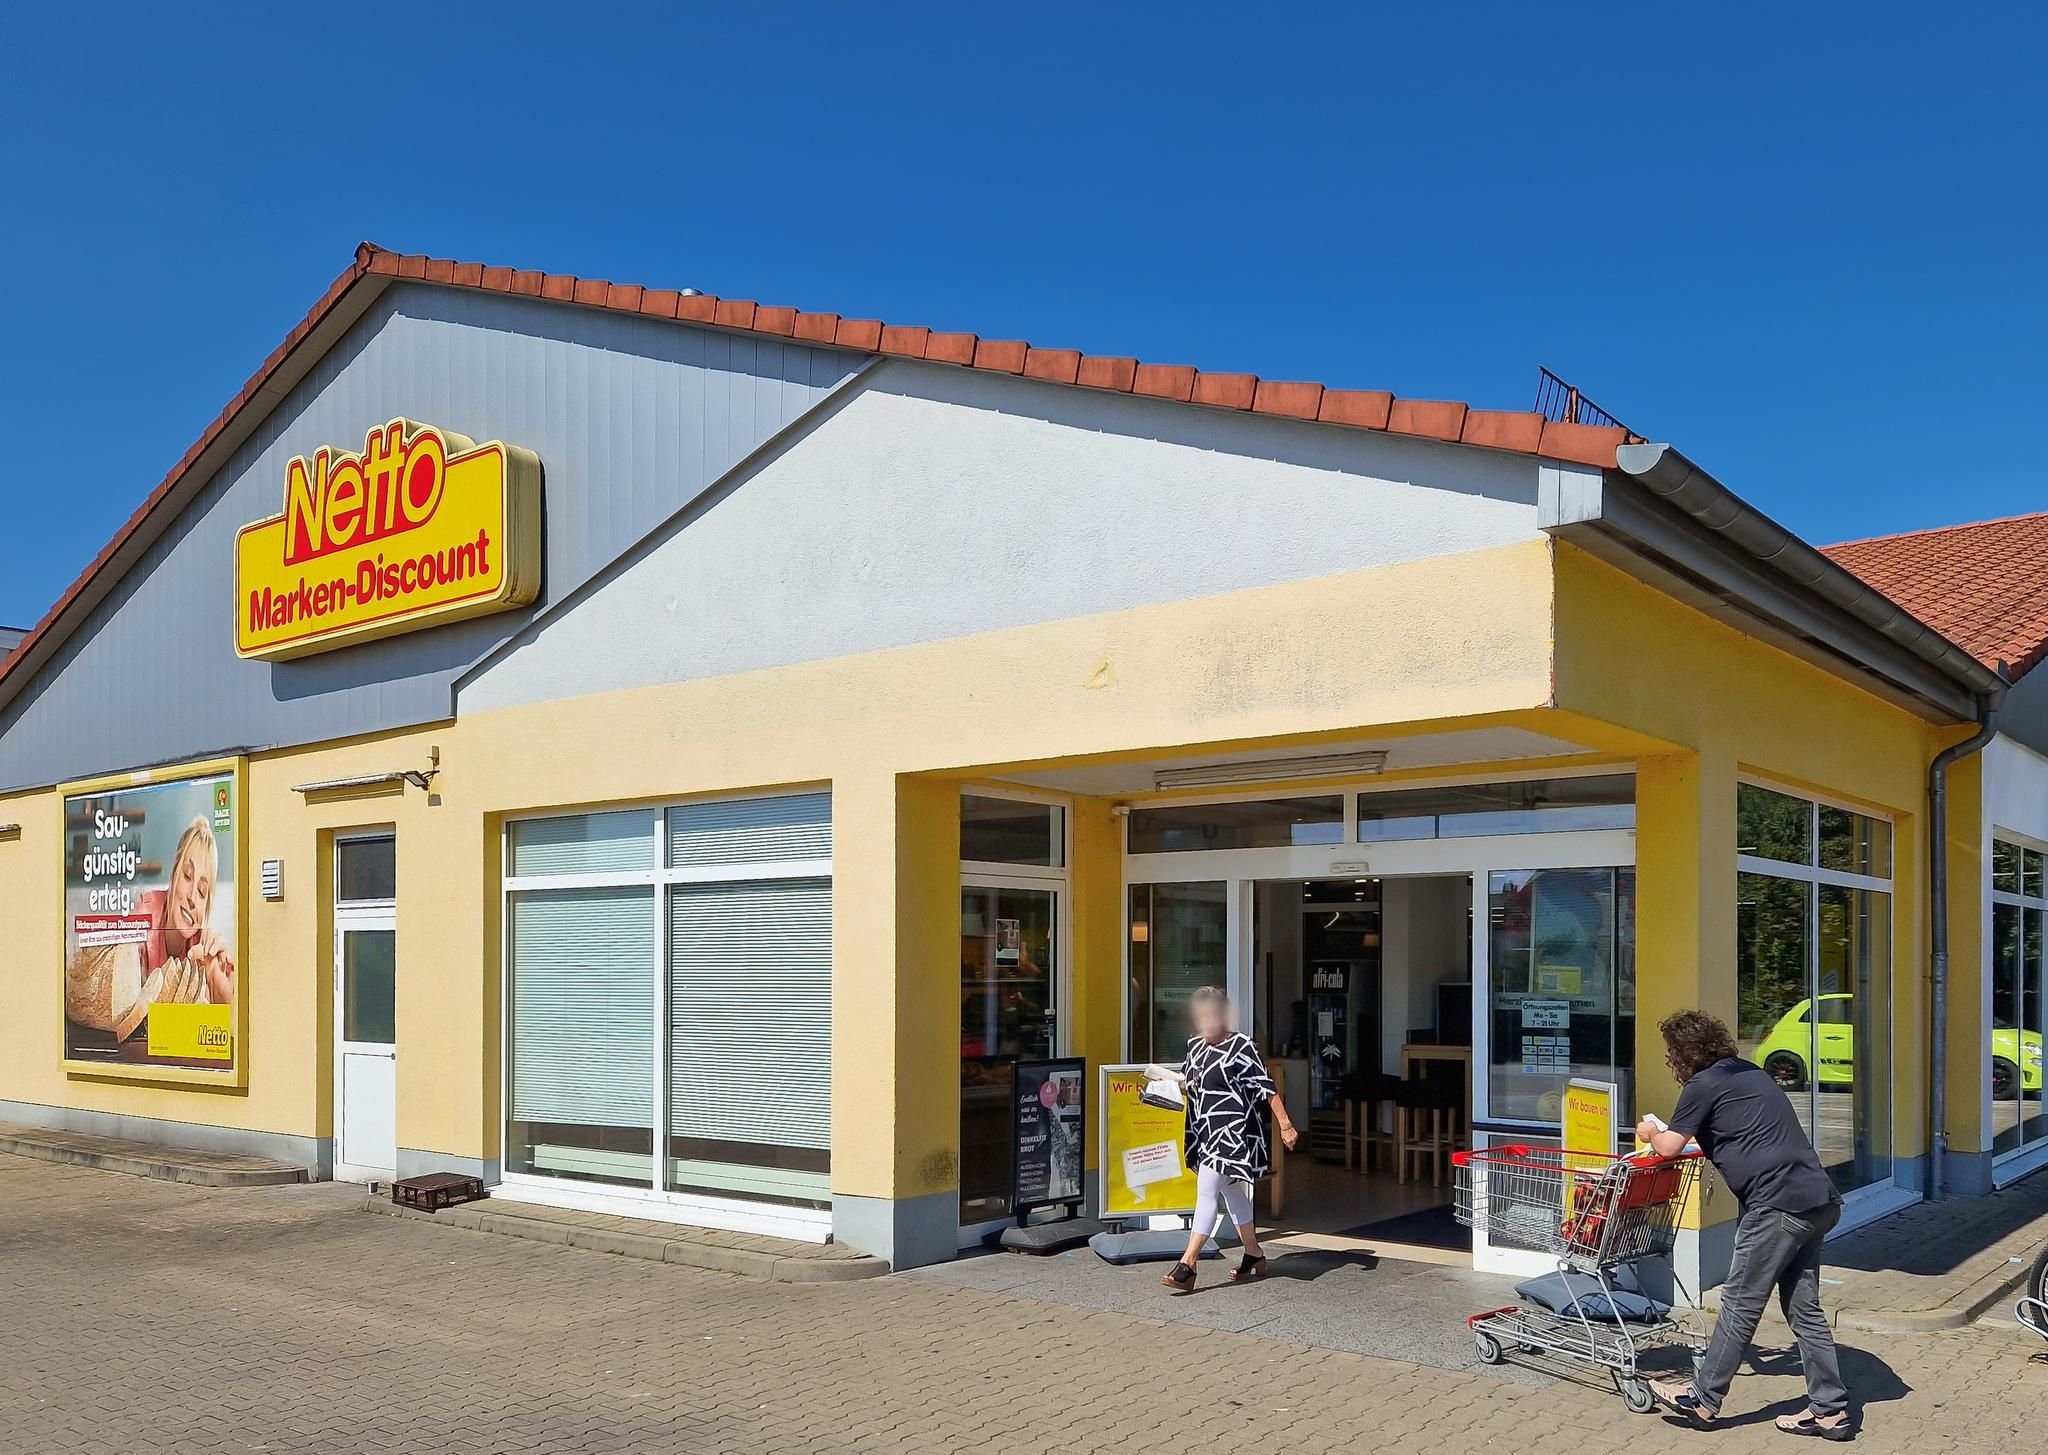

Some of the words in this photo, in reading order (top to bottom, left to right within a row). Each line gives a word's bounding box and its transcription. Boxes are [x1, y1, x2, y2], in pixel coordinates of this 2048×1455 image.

[284, 425, 445, 562] Netto
[250, 529, 490, 632] Marken-Discount
[95, 809, 128, 839] Sau-
[83, 843, 141, 882] günstig-
[89, 880, 135, 917] erteig.
[1523, 1002, 1568, 1011] Öffnungszeiten
[198, 1025, 229, 1046] Netto
[1112, 1082, 1132, 1093] Wir
[1568, 1097, 1579, 1111] Wir
[1580, 1100, 1599, 1115] bauen
[1020, 1145, 1035, 1153] BROT
